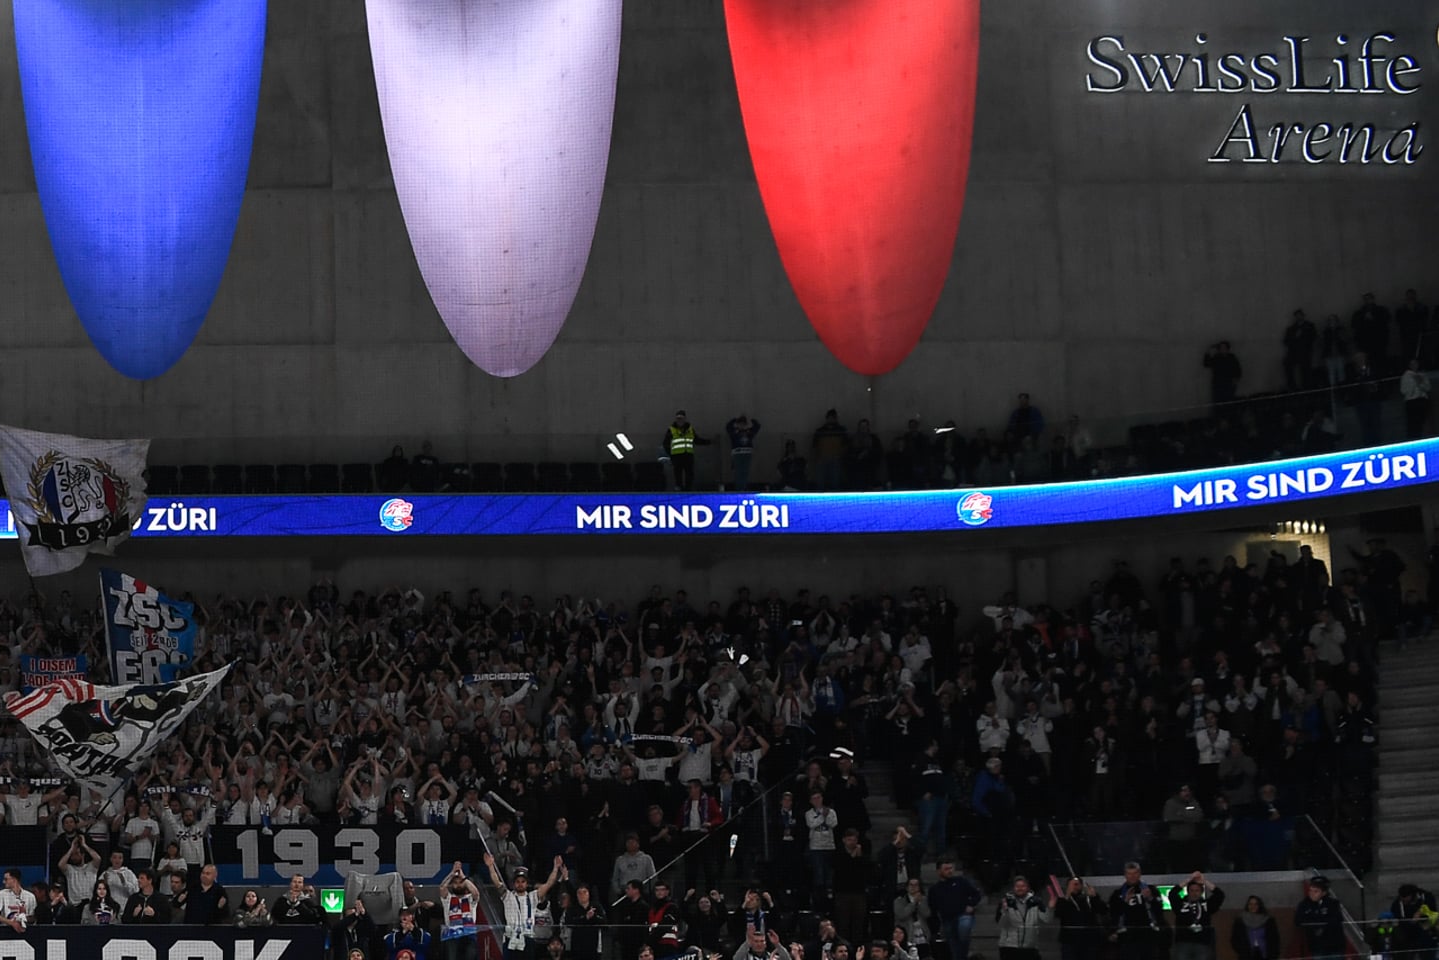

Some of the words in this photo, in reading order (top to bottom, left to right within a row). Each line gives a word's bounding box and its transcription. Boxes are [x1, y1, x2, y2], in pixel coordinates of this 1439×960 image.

[1173, 477, 1237, 508] MIR
[1246, 466, 1334, 500] SIND
[1341, 452, 1426, 488] ZÜRI
[147, 501, 217, 532] ZÜRI
[576, 505, 632, 528] MIR
[640, 504, 713, 528] SIND
[719, 500, 789, 528] ZÜRI
[110, 587, 185, 629] ZSC
[236, 828, 442, 881] 1930
